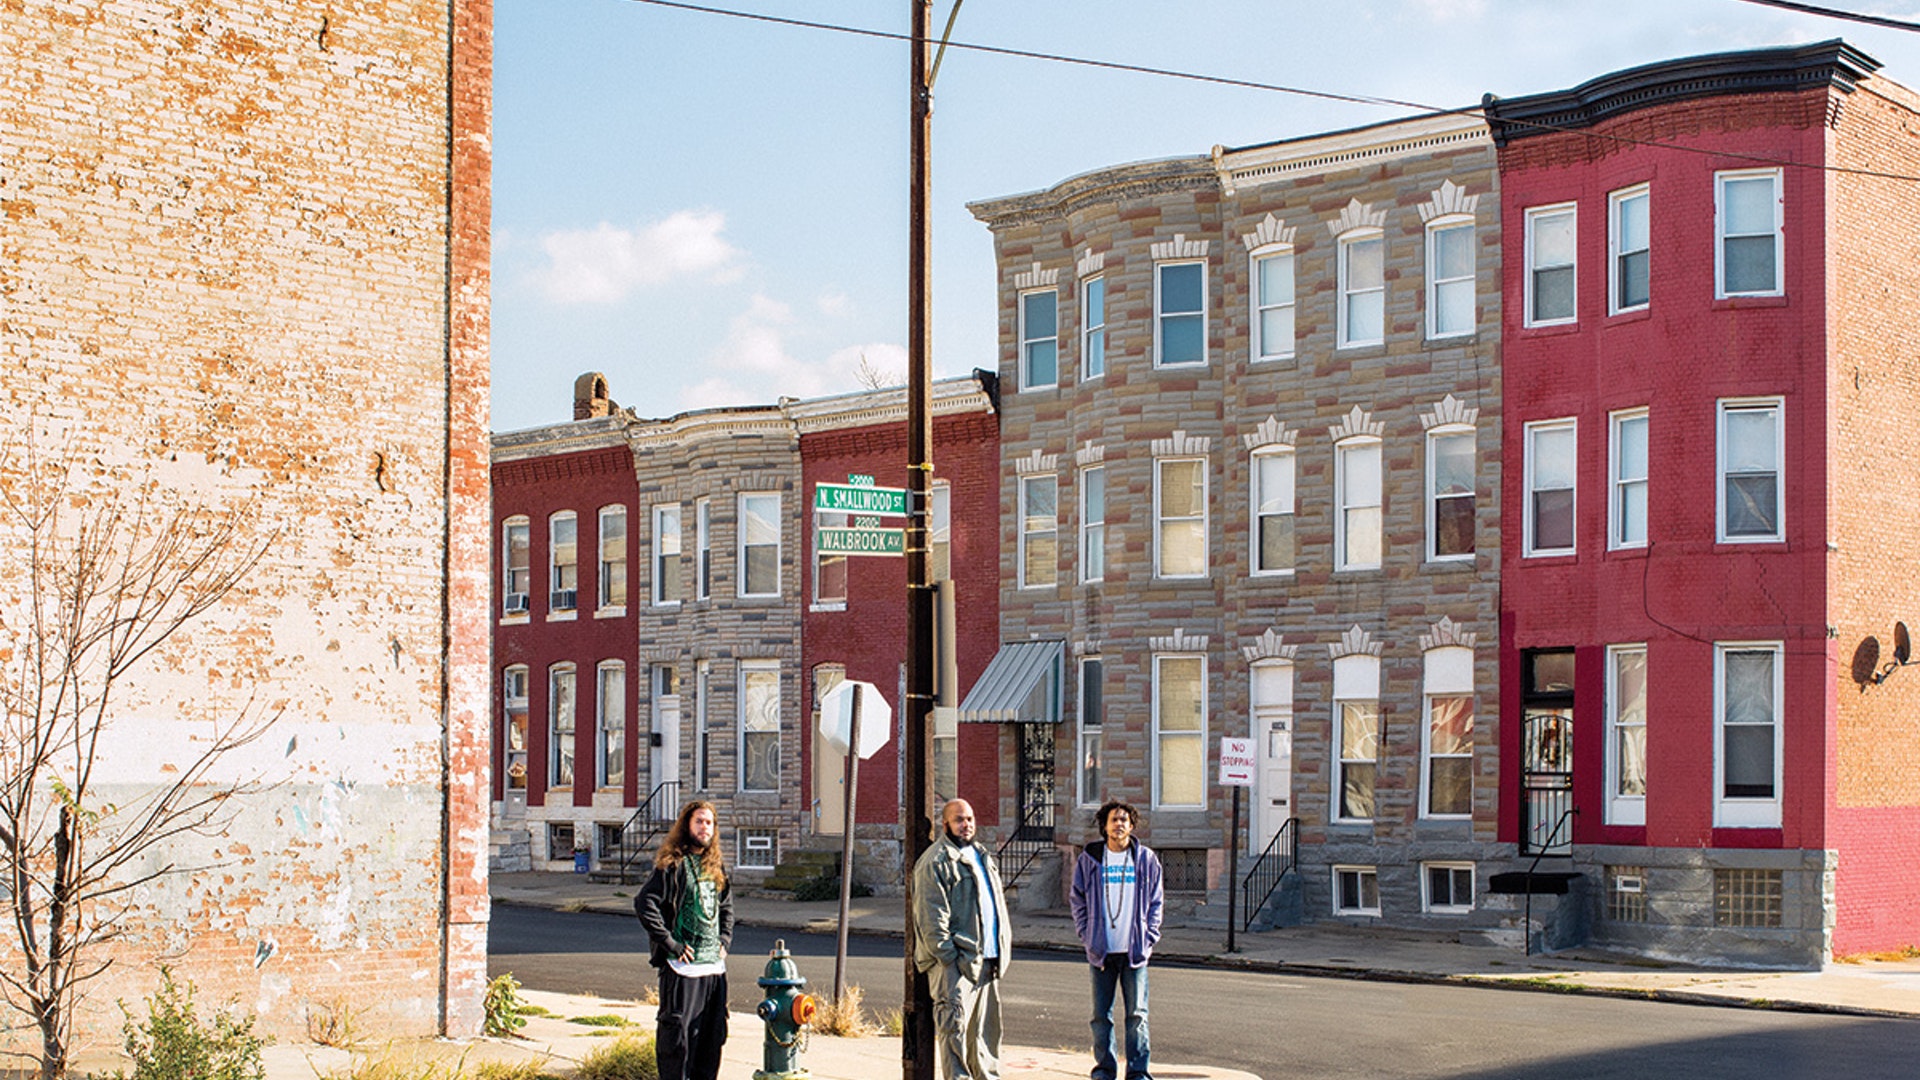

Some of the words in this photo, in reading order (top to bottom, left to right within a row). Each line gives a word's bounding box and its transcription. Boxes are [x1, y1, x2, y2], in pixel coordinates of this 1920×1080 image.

[833, 489, 892, 511] SMALLWOOD
[821, 531, 887, 550] WALBROOK
[1231, 743, 1245, 753] NO
[1221, 756, 1255, 767] STOPPING
